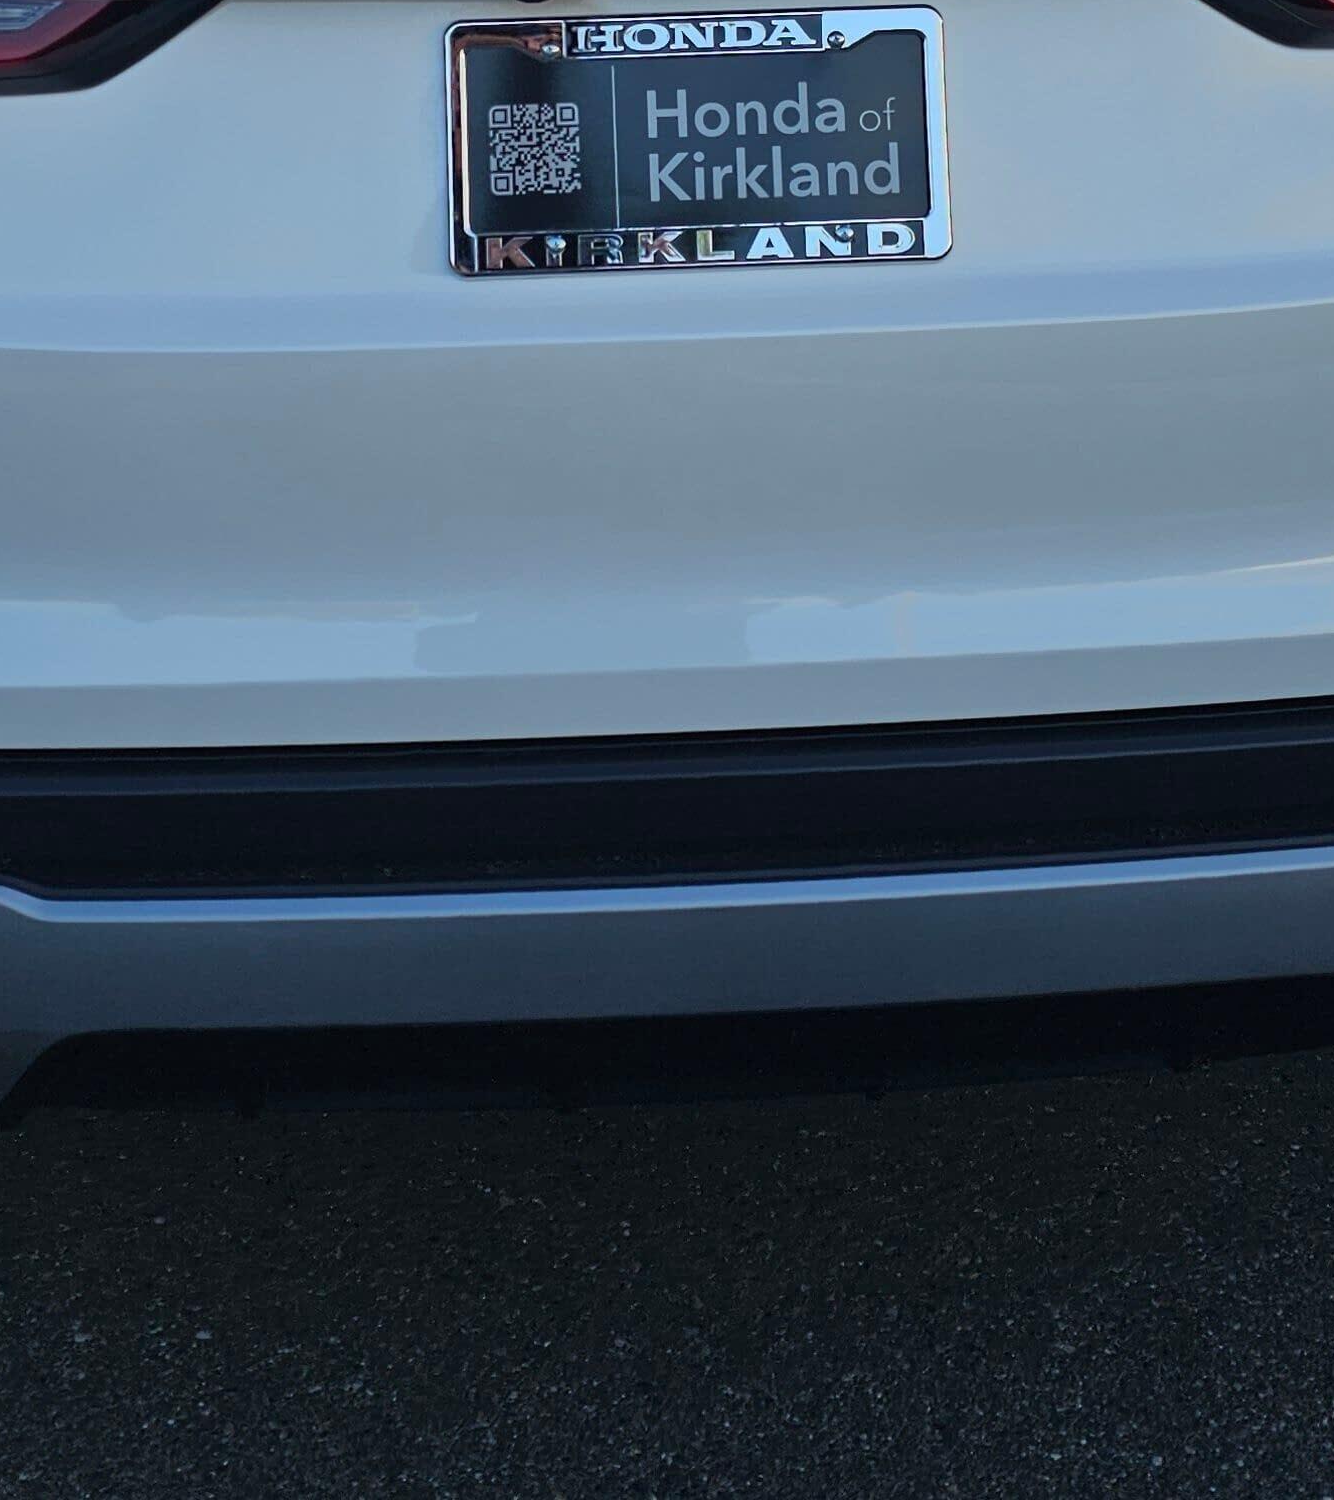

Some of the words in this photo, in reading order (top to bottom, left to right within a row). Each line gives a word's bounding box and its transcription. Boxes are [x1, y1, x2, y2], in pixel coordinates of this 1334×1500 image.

[575, 17, 816, 54] HONDA
[645, 81, 847, 140] Honda
[858, 95, 897, 132] of
[647, 141, 901, 202] Kirkland
[484, 222, 916, 269] KIRKLAND
